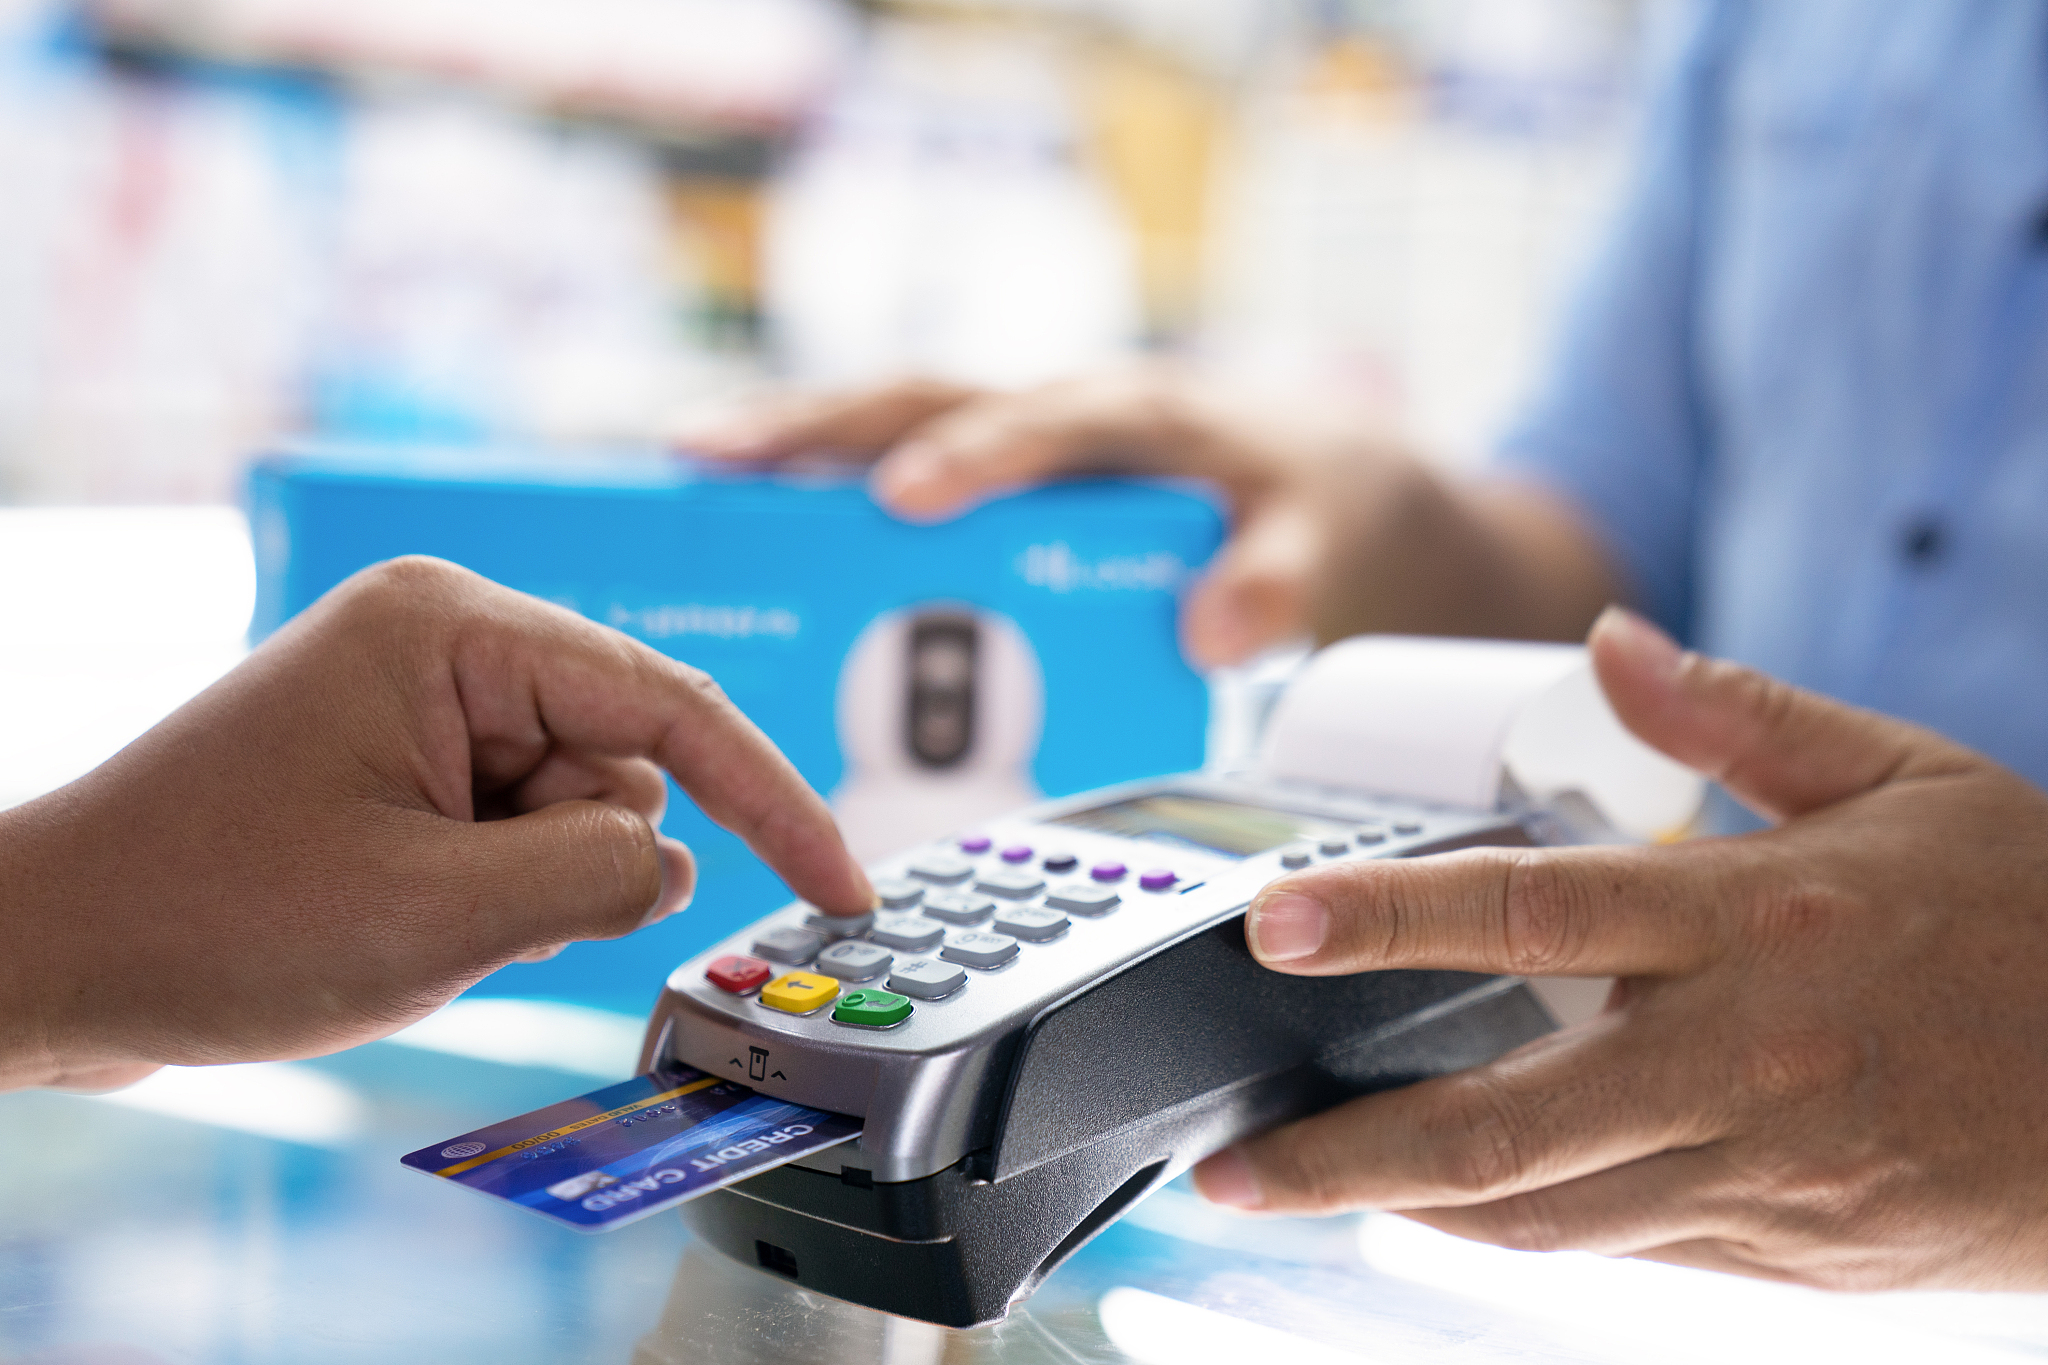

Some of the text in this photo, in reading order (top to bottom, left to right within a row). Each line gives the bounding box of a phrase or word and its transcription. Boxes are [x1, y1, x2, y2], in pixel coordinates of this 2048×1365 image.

[511, 1103, 643, 1151] VALID DATES 00/00
[581, 1124, 814, 1211] CREDIT CARD
